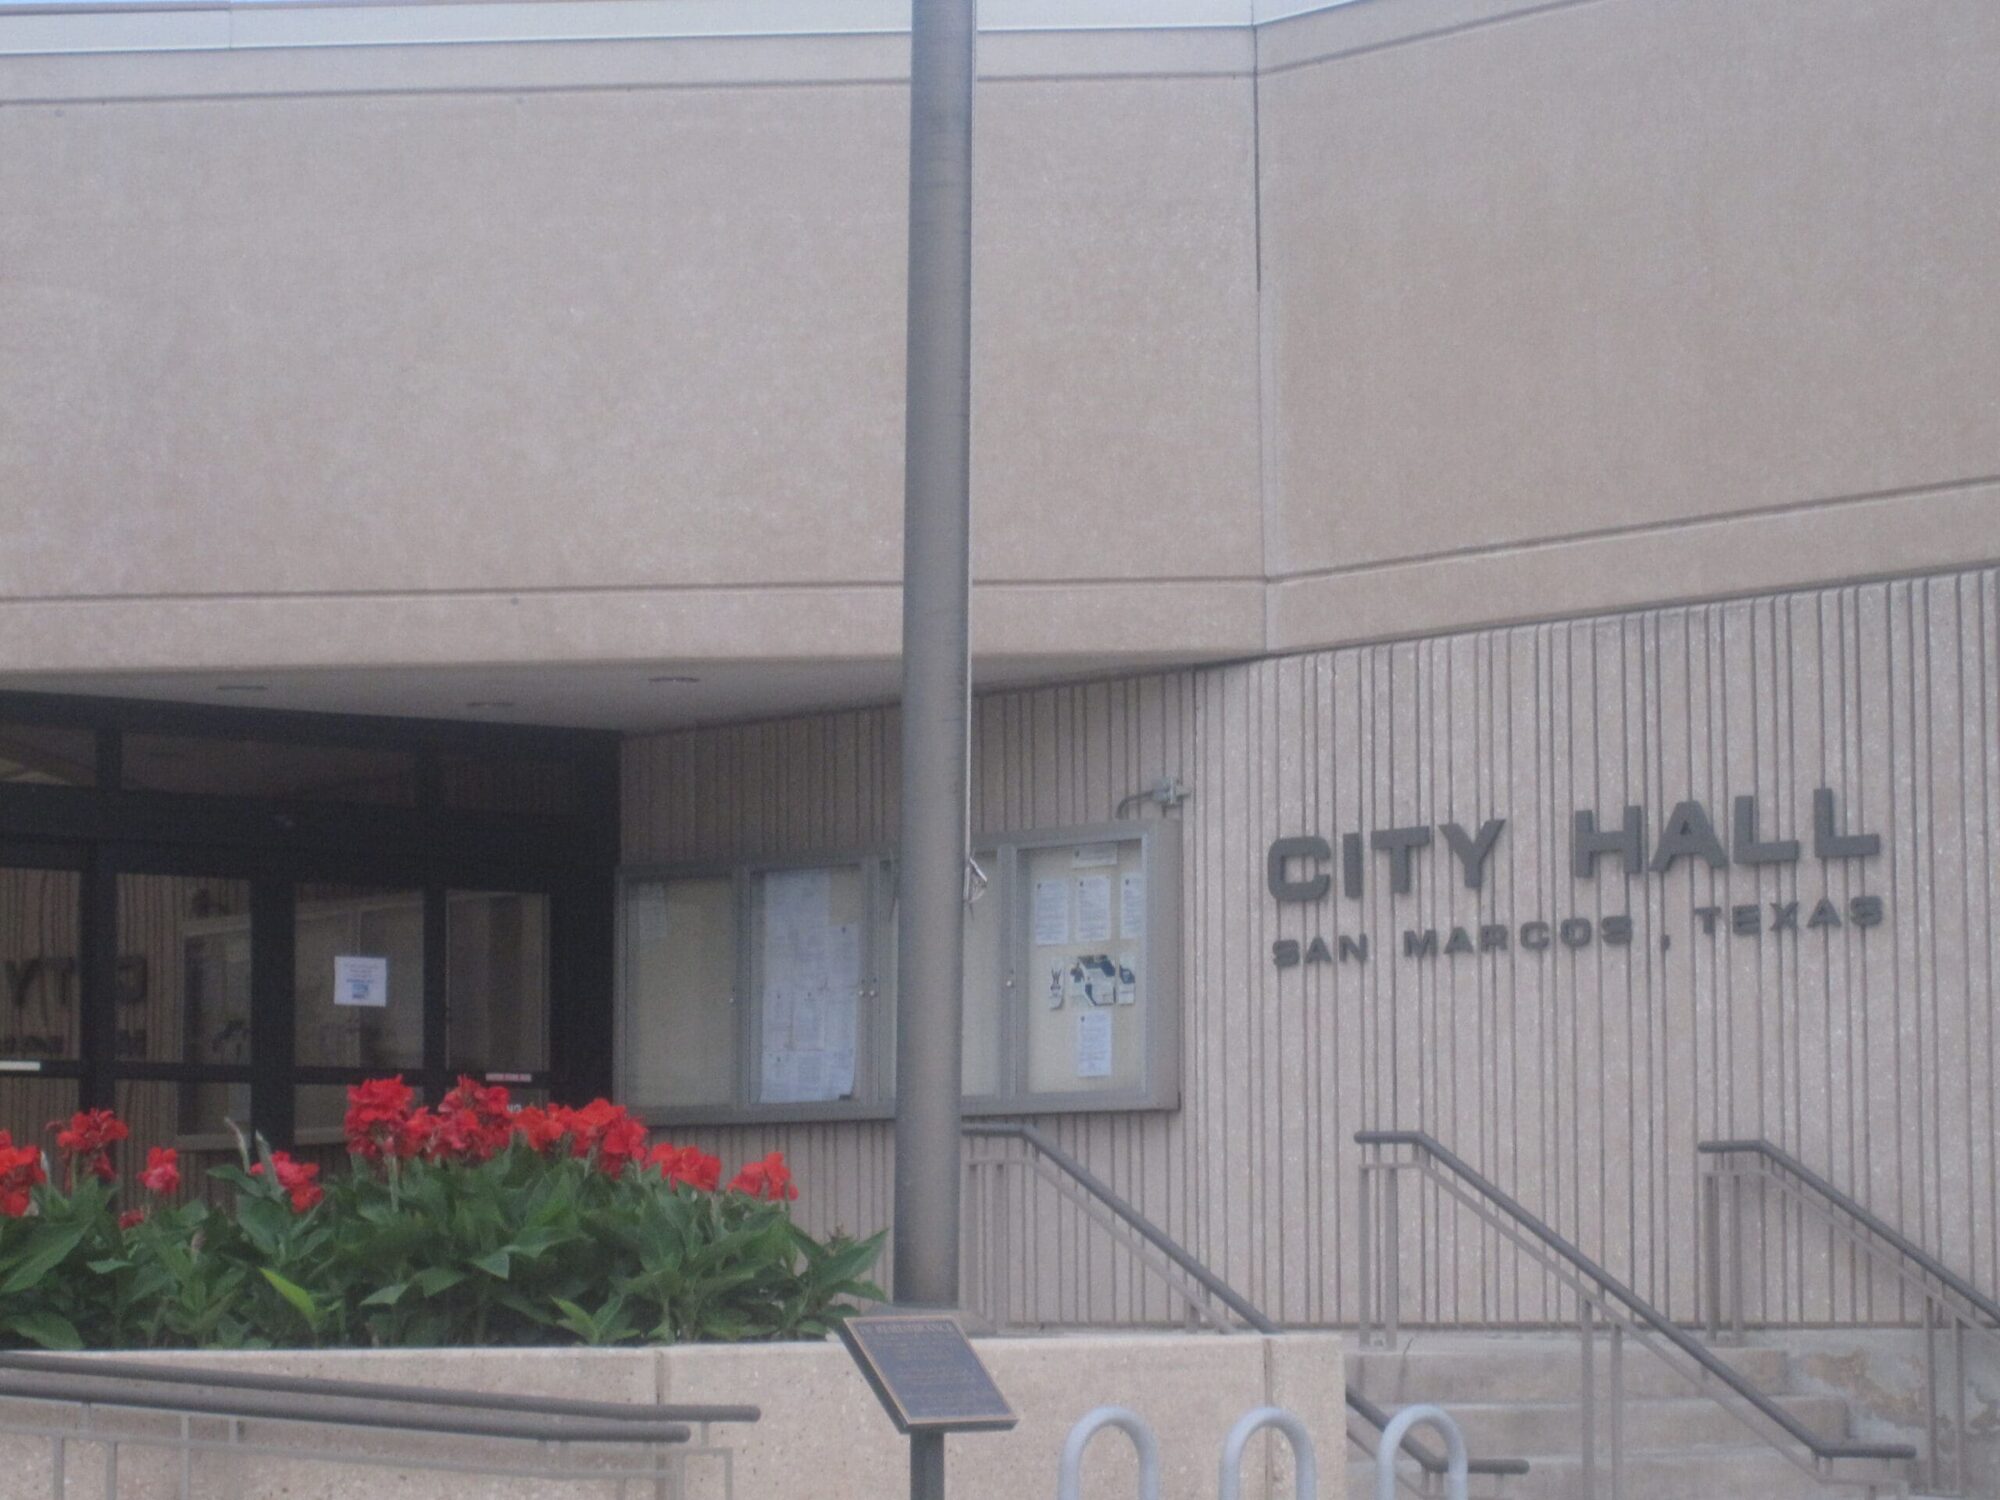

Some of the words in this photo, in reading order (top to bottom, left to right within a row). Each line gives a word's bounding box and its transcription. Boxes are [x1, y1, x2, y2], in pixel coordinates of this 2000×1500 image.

[1267, 817, 1506, 902] CITY
[1573, 787, 1880, 878] HALL
[1272, 932, 1369, 967] SAN
[1694, 895, 1884, 935] TEXAS
